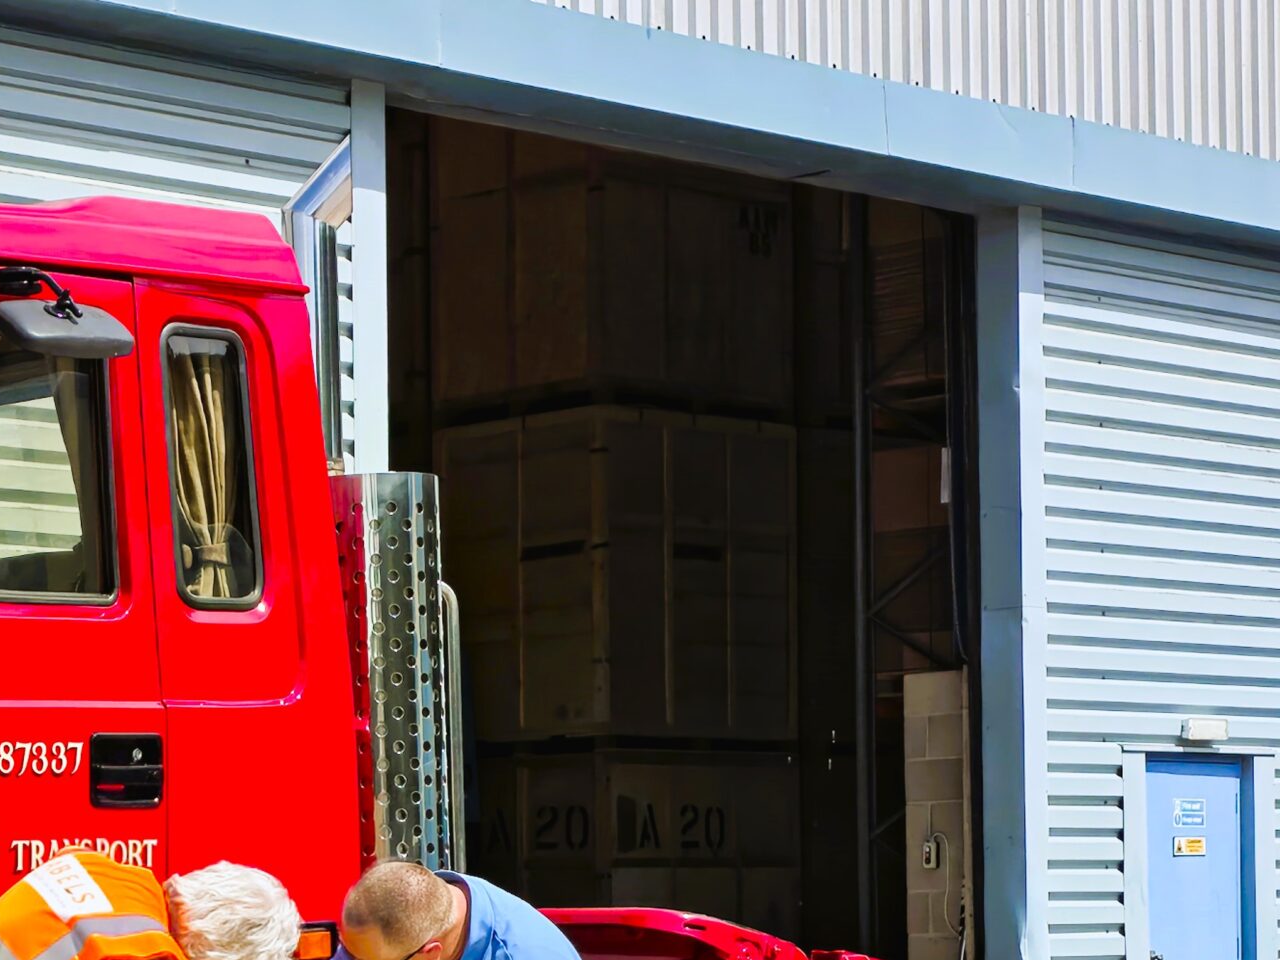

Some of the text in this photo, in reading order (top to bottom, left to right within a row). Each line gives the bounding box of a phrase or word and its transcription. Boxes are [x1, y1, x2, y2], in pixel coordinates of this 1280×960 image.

[534, 804, 590, 851] 20
[638, 802, 726, 852] A 20
[10, 837, 158, 872] TRAPORT
